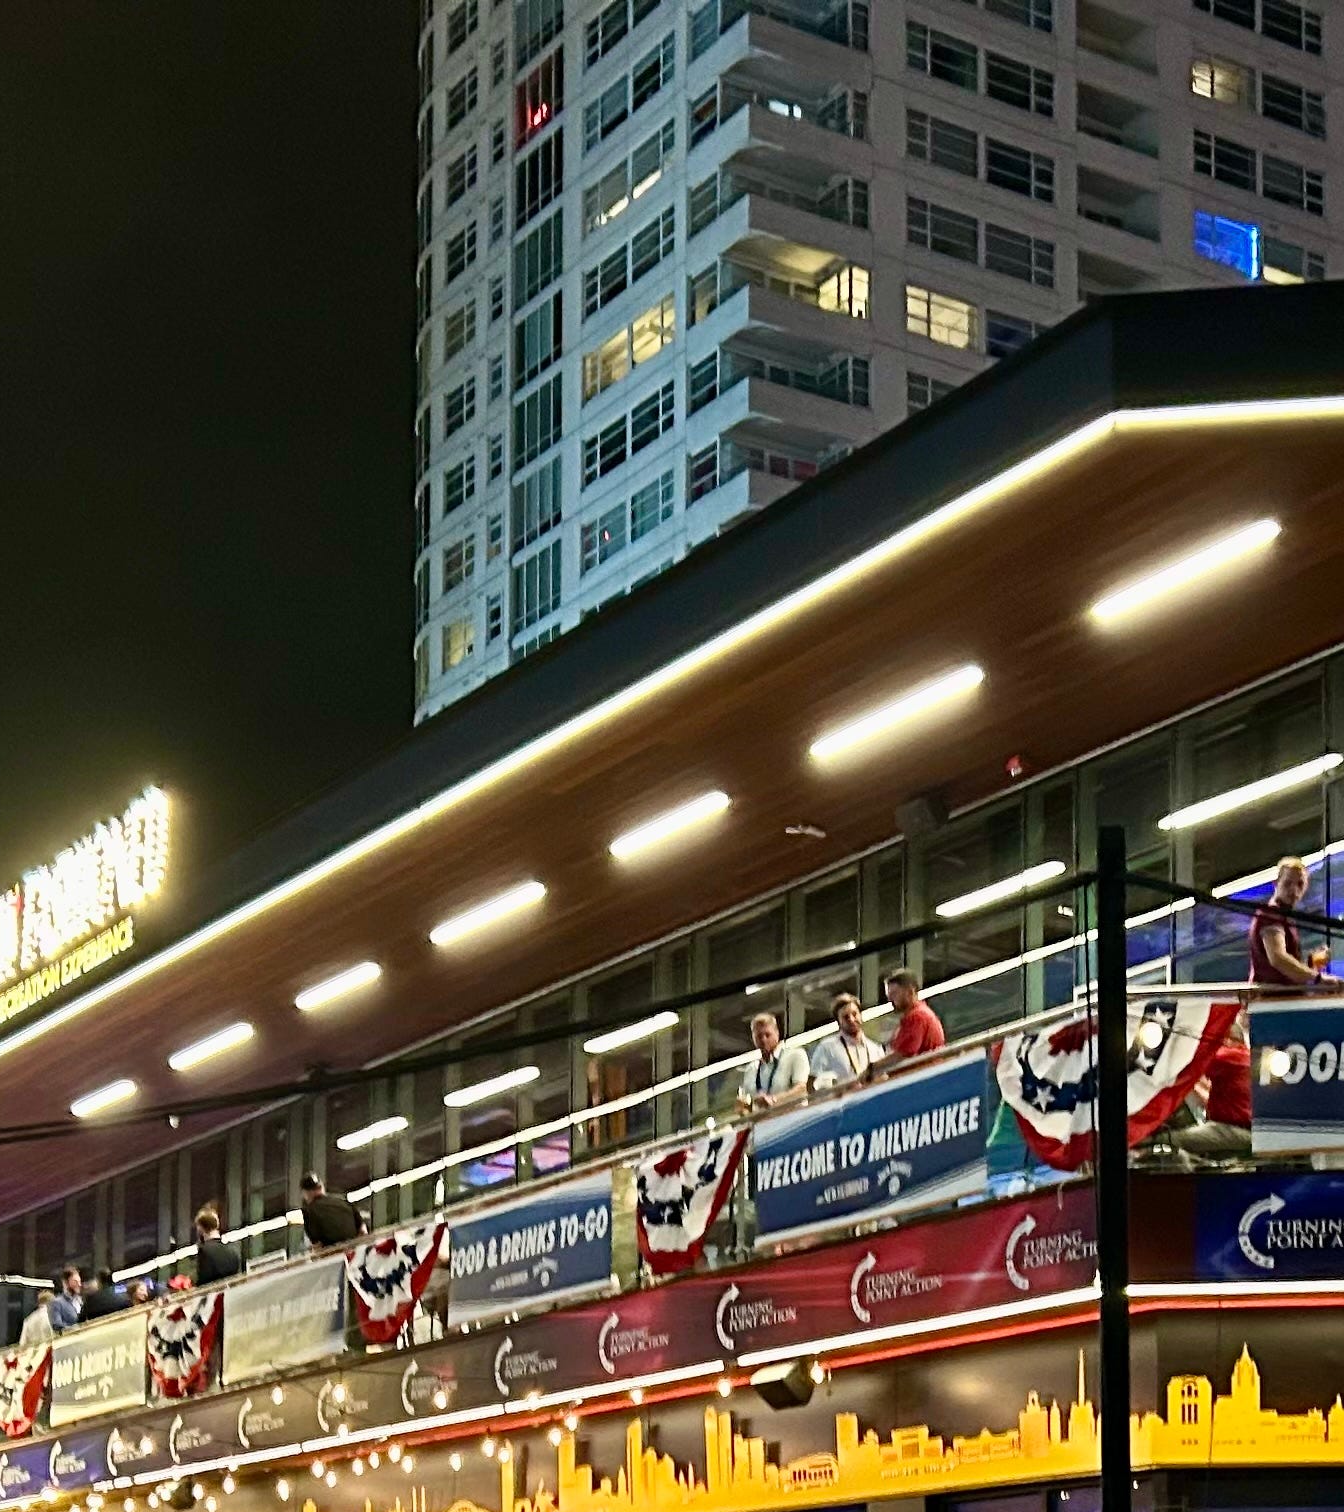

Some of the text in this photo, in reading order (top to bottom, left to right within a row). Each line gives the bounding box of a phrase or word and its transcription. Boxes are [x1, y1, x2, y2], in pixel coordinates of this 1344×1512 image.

[757, 1140, 836, 1193] WELCOME
[839, 1132, 866, 1169] TO
[868, 1096, 981, 1163] MILWAUKEE
[500, 1219, 557, 1266] DRINKS
[559, 1204, 609, 1249] TO-GO
[1022, 1228, 1083, 1254] TURNING
[1266, 1231, 1328, 1250] POINT
[1022, 1239, 1099, 1269] POINT ACTI
[864, 1270, 916, 1290] TURNING
[865, 1274, 943, 1304] POINT ACTION
